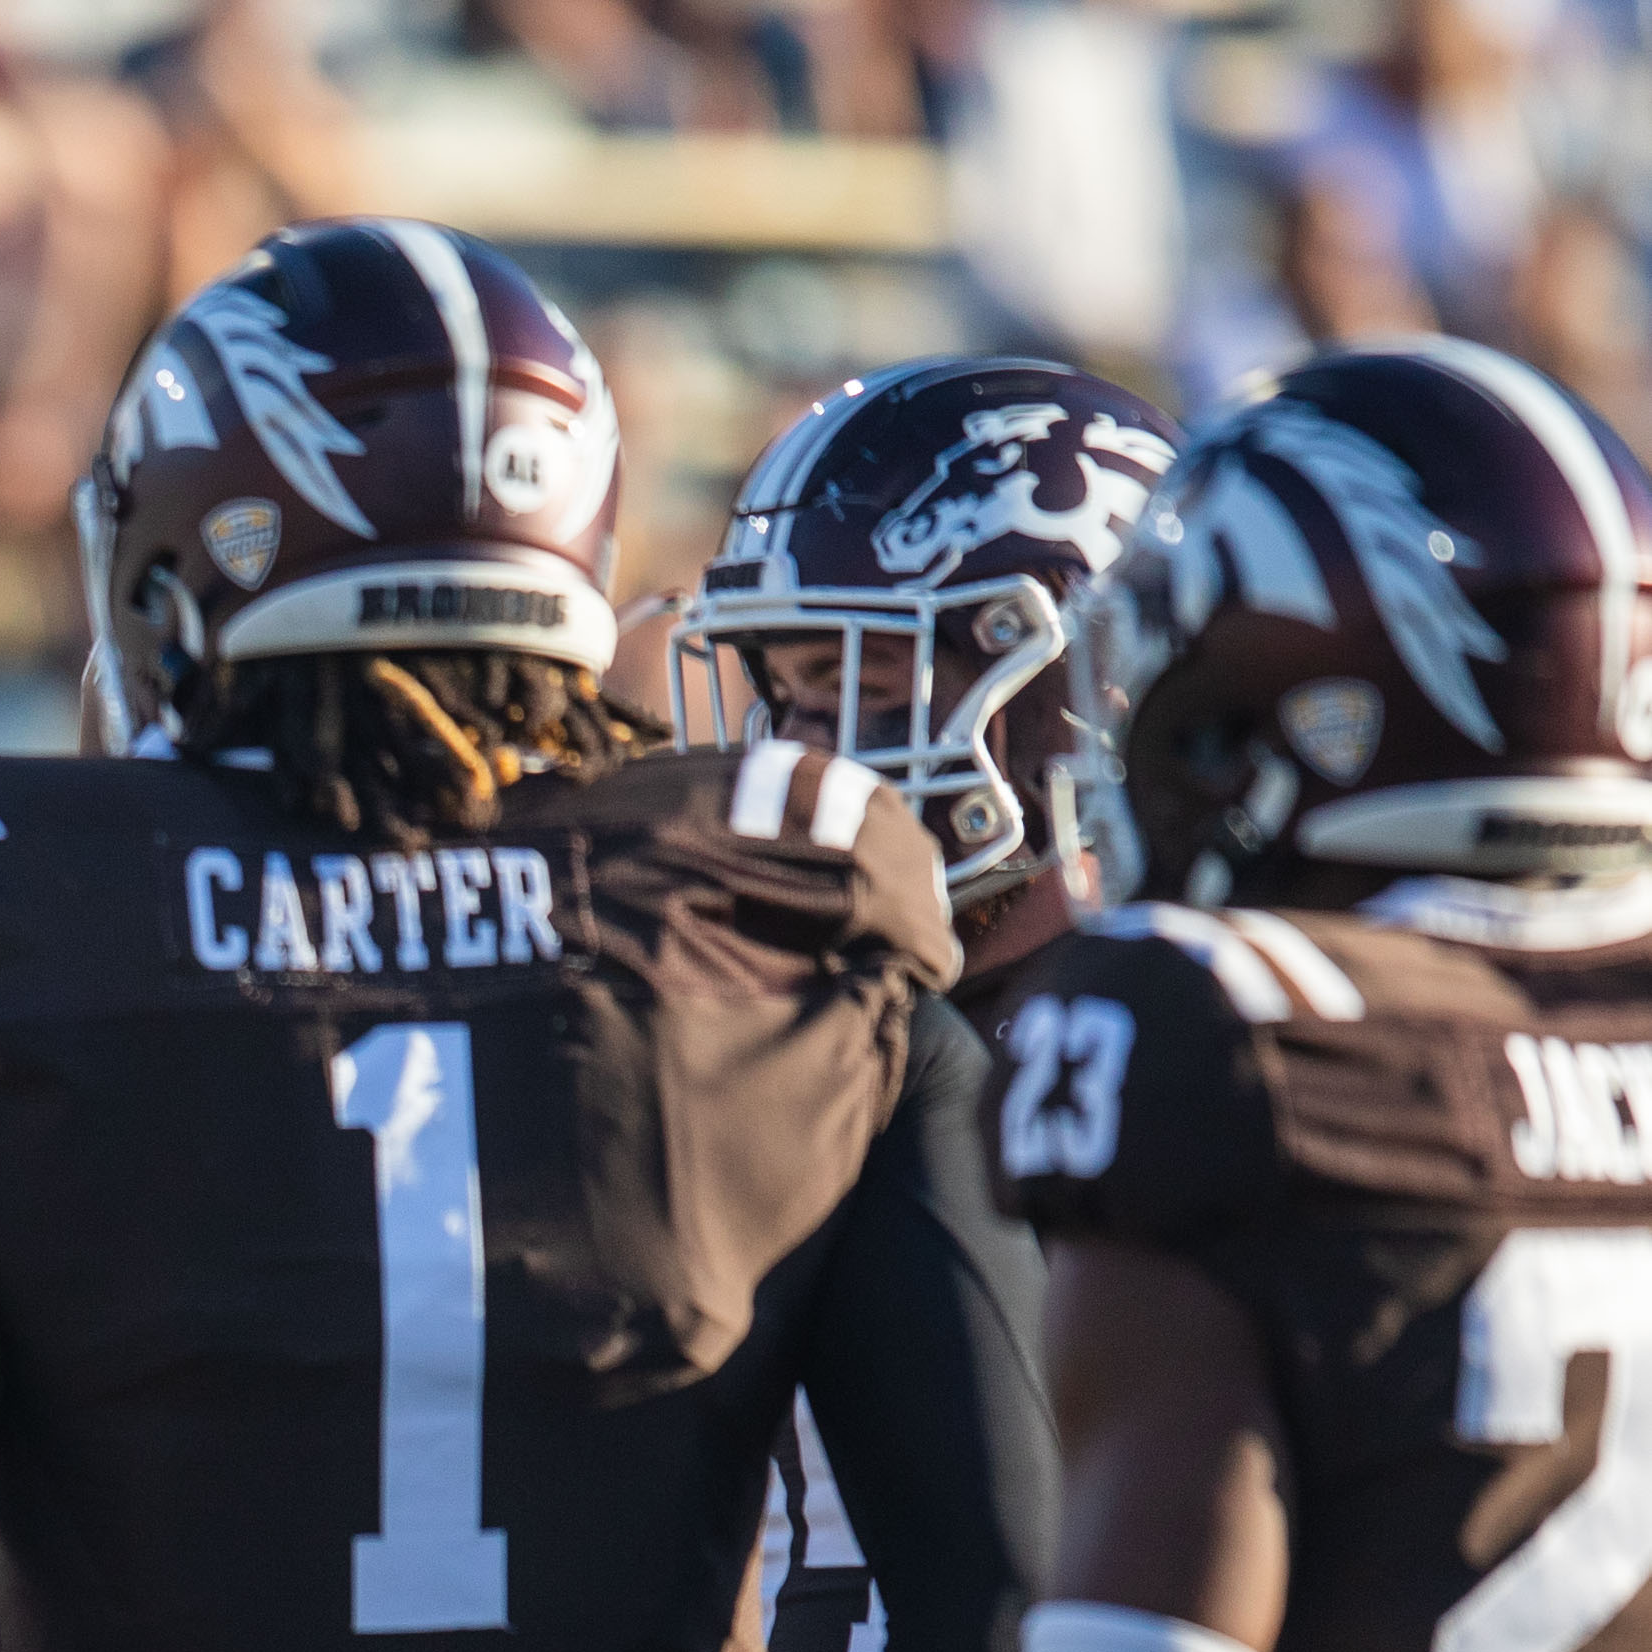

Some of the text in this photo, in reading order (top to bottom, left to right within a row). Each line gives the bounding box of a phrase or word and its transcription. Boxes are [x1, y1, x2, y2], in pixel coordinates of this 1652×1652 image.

[184, 846, 563, 973] CARTER
[1000, 993, 1137, 1179] 23
[329, 1020, 509, 1635] 1
